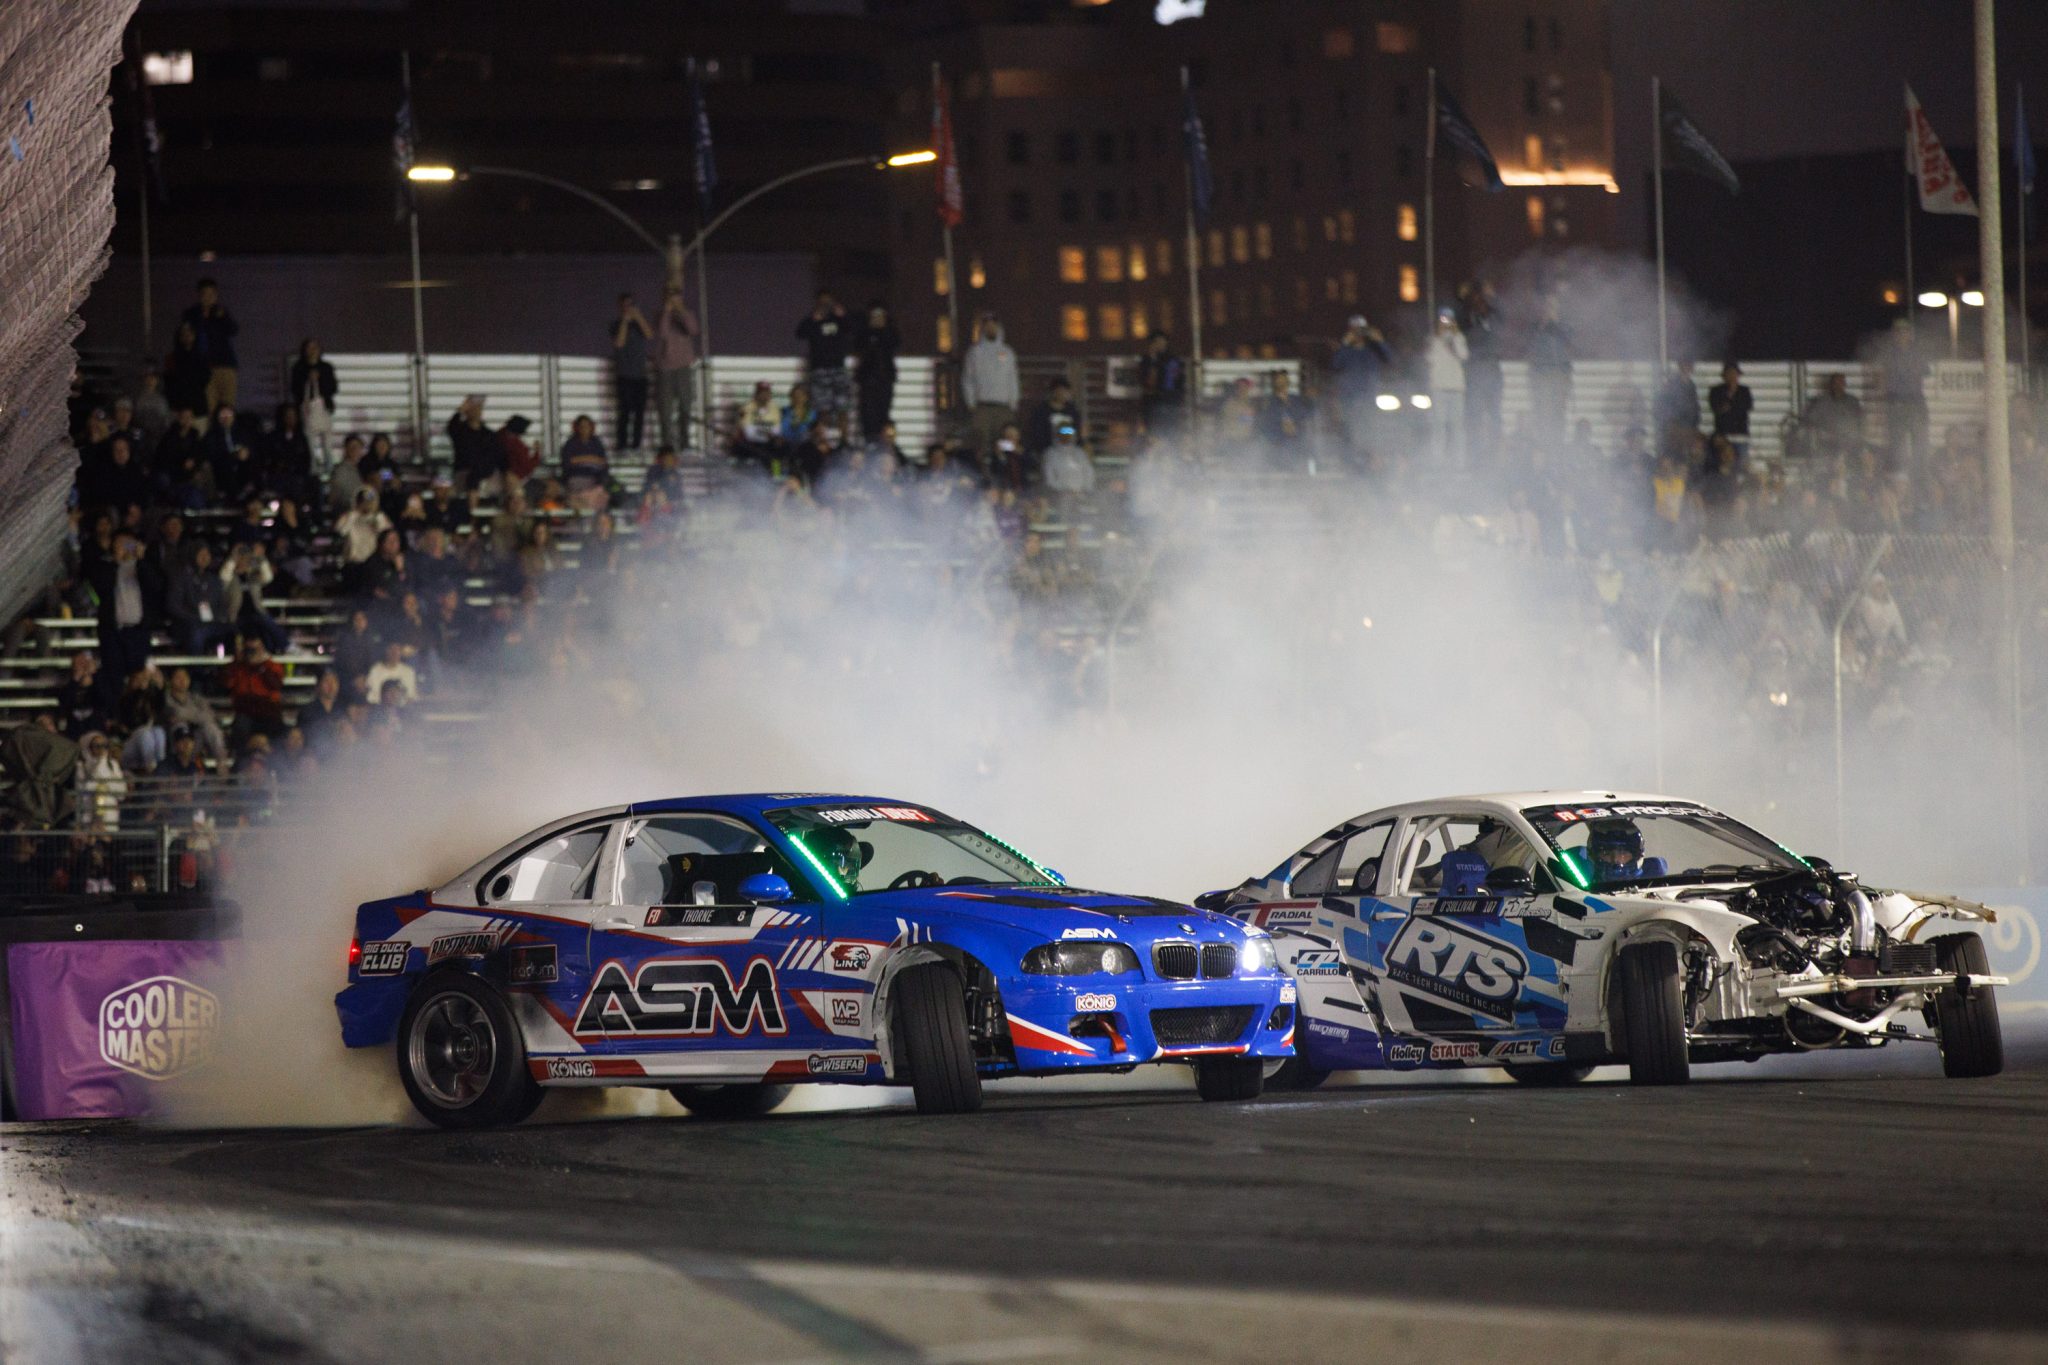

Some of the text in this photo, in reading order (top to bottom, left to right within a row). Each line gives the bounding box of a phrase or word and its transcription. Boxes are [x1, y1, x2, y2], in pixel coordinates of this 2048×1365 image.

[818, 807, 932, 823] FORMULA DRIFT
[1270, 911, 1313, 919] RADIAL
[1439, 902, 1476, 913] O'SULLIVAN
[1483, 902, 1496, 913] 107
[647, 909, 661, 924] FD
[682, 909, 746, 923] THORNE 8
[1061, 927, 1118, 939] ASM
[364, 943, 407, 953] BIG DUCK
[362, 955, 403, 970] CLUB
[1390, 917, 1523, 997] RTS
[1297, 968, 1339, 976] CARRILLO
[1392, 968, 1410, 982] RACE
[1412, 974, 1431, 988] TECH
[1434, 983, 1470, 1003] SERVICES
[574, 958, 787, 1036] ASM
[1077, 993, 1116, 1011] KÖNIG
[107, 984, 215, 1029] COOLER
[833, 1000, 859, 1019] WP
[1392, 1046, 1424, 1063] Holley
[1507, 1041, 1541, 1055] ACT
[548, 1058, 595, 1078] KÖNIG
[823, 1058, 865, 1072] WISEFAB
